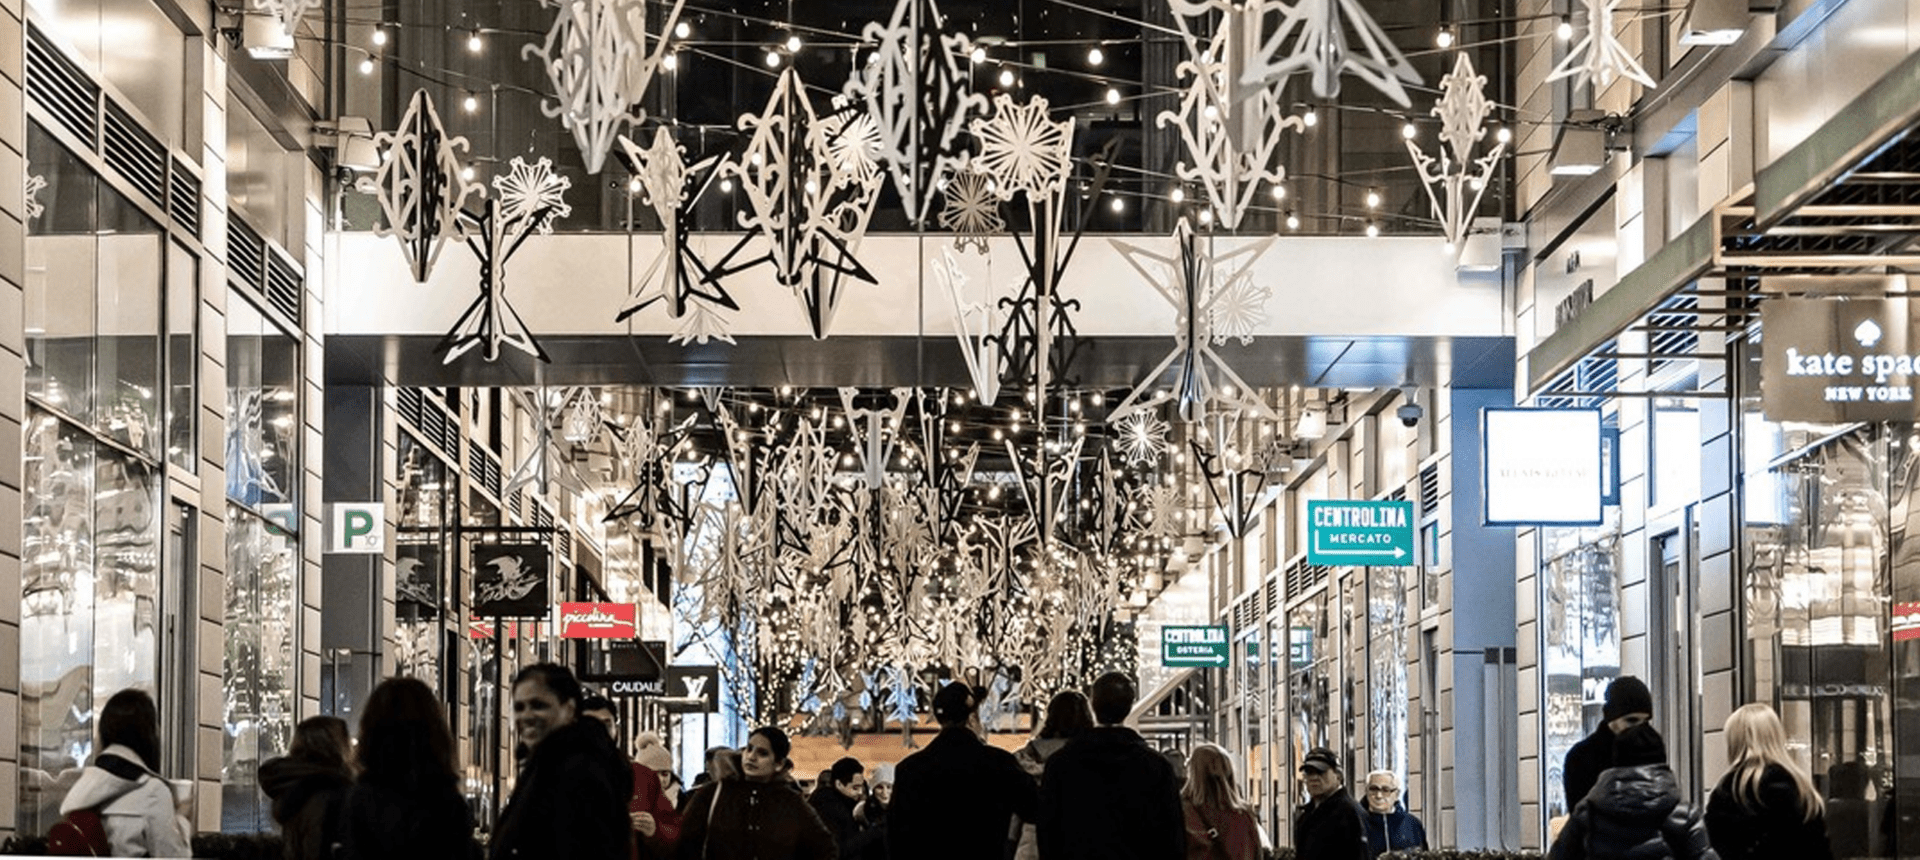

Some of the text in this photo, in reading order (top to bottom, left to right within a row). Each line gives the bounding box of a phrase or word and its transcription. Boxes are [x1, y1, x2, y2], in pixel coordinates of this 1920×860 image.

[1786, 347, 1853, 375] kate
[1824, 386, 1912, 401] NEW YORK
[1314, 506, 1407, 528] CENTROLINA
[344, 509, 374, 548] P
[1329, 533, 1391, 544] MERCATO
[1165, 629, 1225, 643] CENTROLINA
[1176, 646, 1214, 654] OSTERIA
